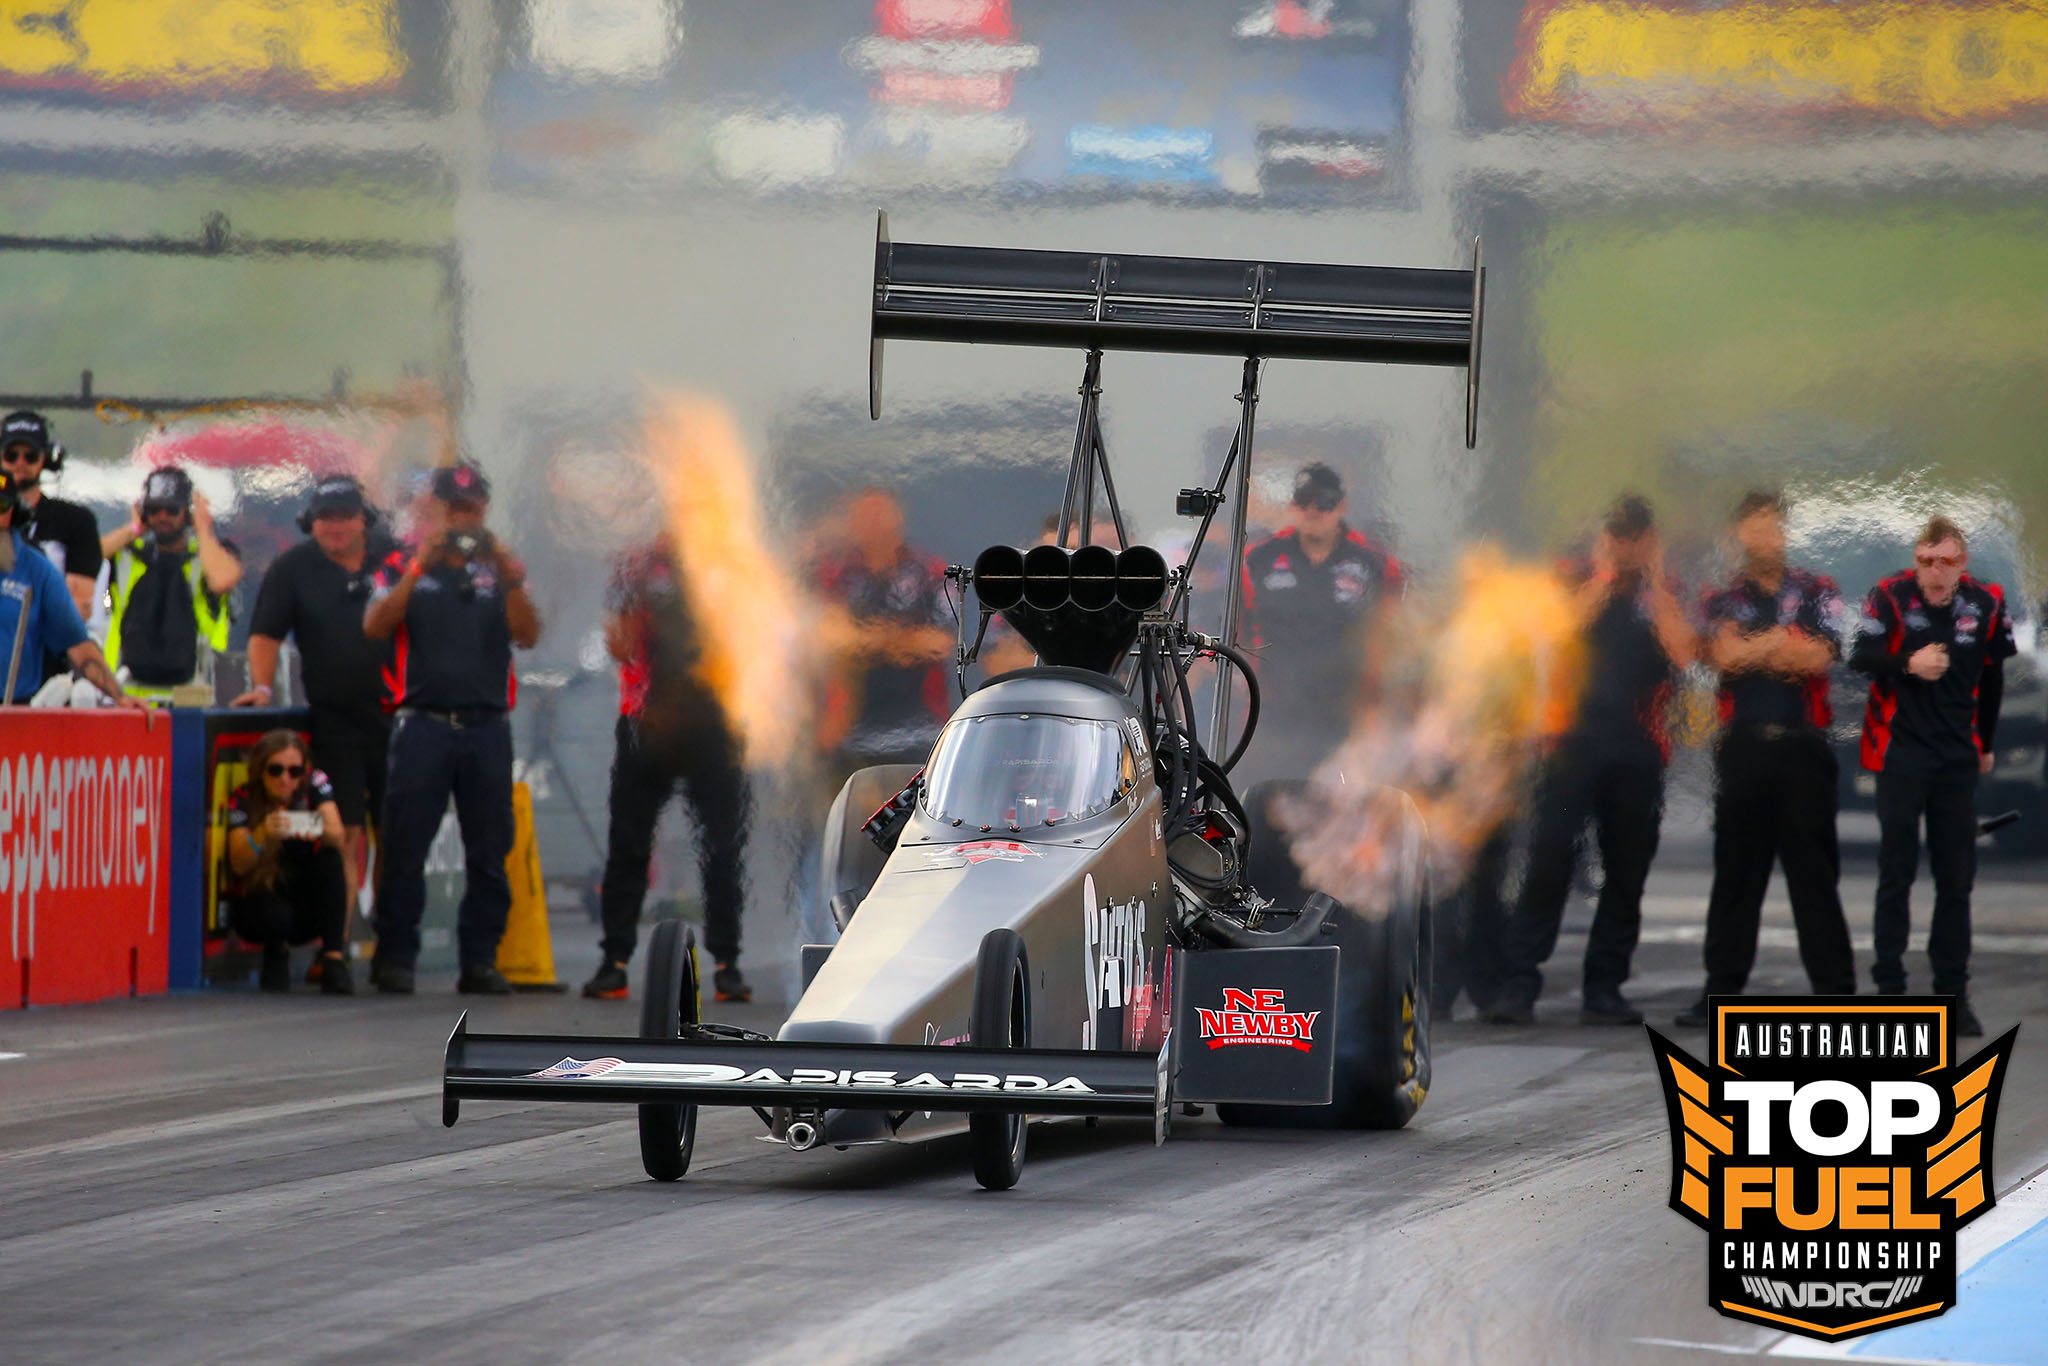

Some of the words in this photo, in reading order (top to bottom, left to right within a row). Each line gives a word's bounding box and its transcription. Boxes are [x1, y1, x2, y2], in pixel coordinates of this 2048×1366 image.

[1223, 988, 1285, 1012] NE
[1194, 1007, 1321, 1040] NEWBY
[1223, 1037, 1293, 1046] ENGINEERING
